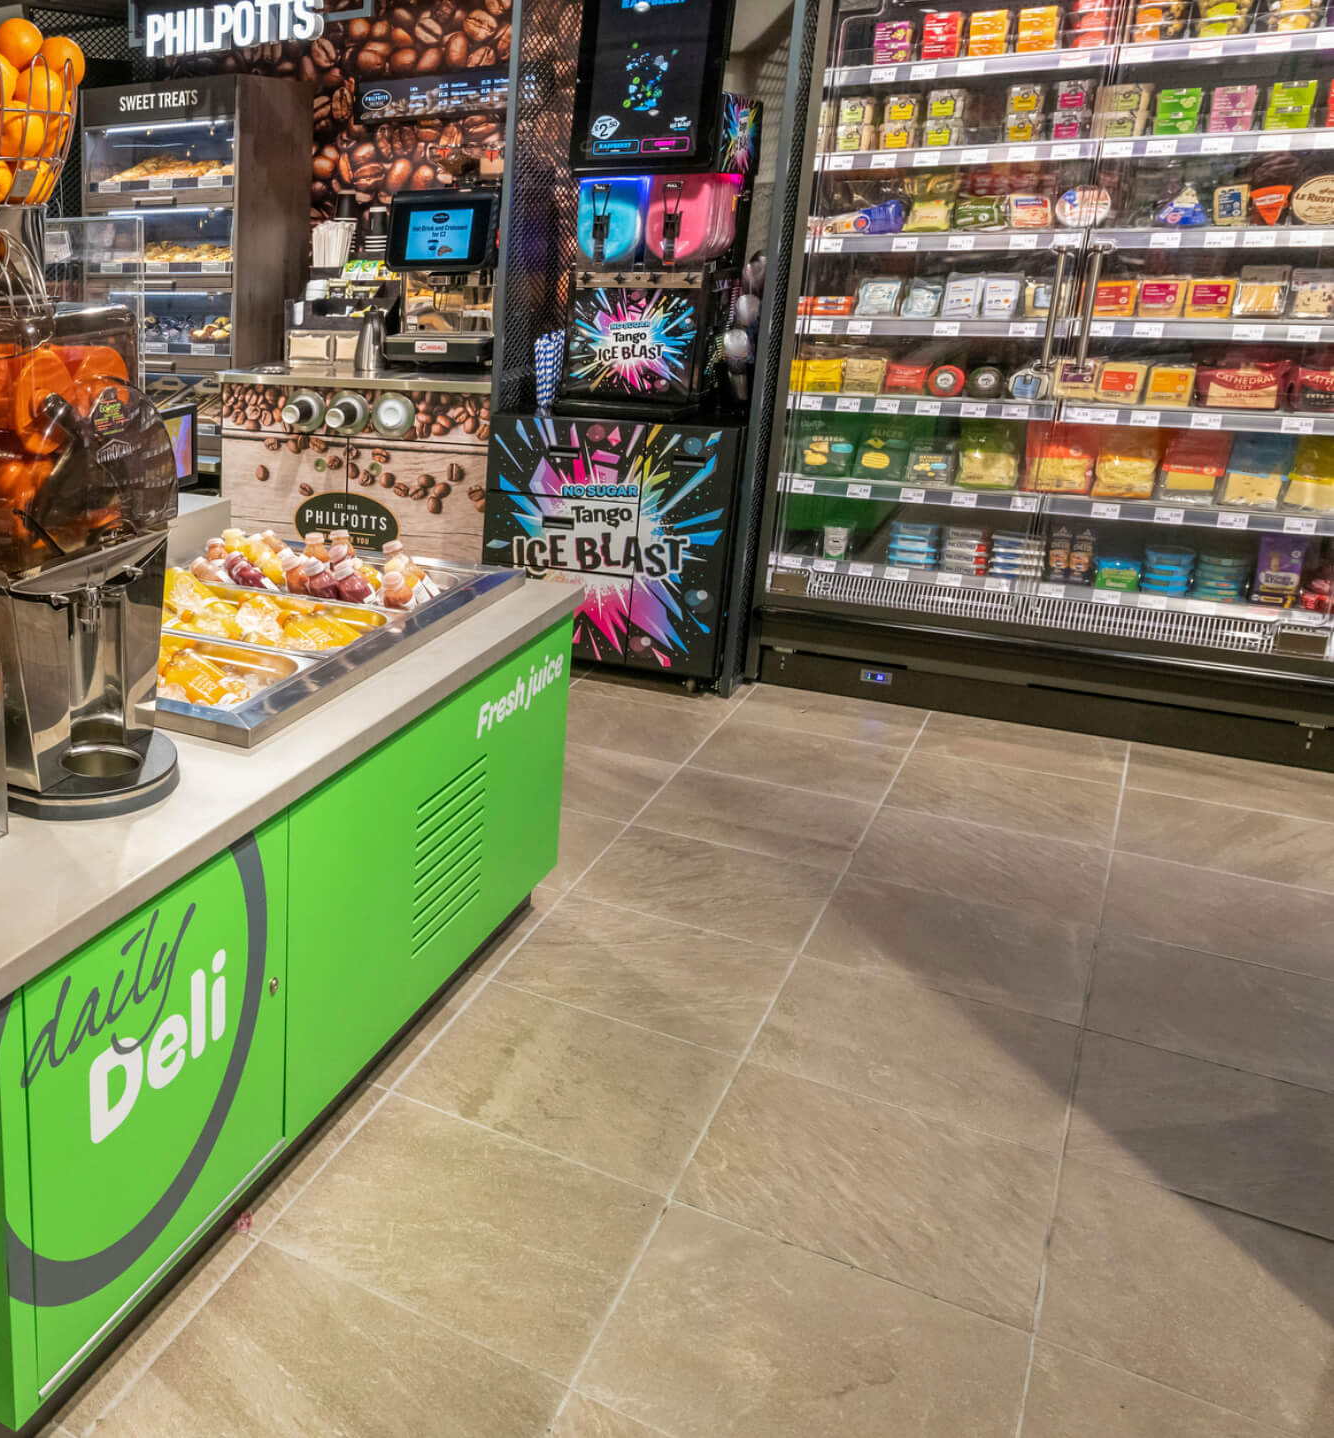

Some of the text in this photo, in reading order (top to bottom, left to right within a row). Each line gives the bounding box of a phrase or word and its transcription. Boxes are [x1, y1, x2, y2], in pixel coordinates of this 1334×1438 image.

[146, 0, 323, 57] PHILPOTTS
[119, 89, 198, 112] SWEET TREATS
[612, 332, 647, 344] Tango
[598, 344, 664, 361] ICE BLAST
[1216, 371, 1276, 385] CATHEDRAL
[562, 484, 638, 497] NO SUGAR
[305, 509, 387, 531] PHILPOTTS
[571, 505, 632, 527] Tango
[515, 532, 687, 577] ICE BLAST
[476, 653, 564, 739] Fresh juice
[20, 902, 196, 1088] daily
[89, 949, 226, 1144] Deli
